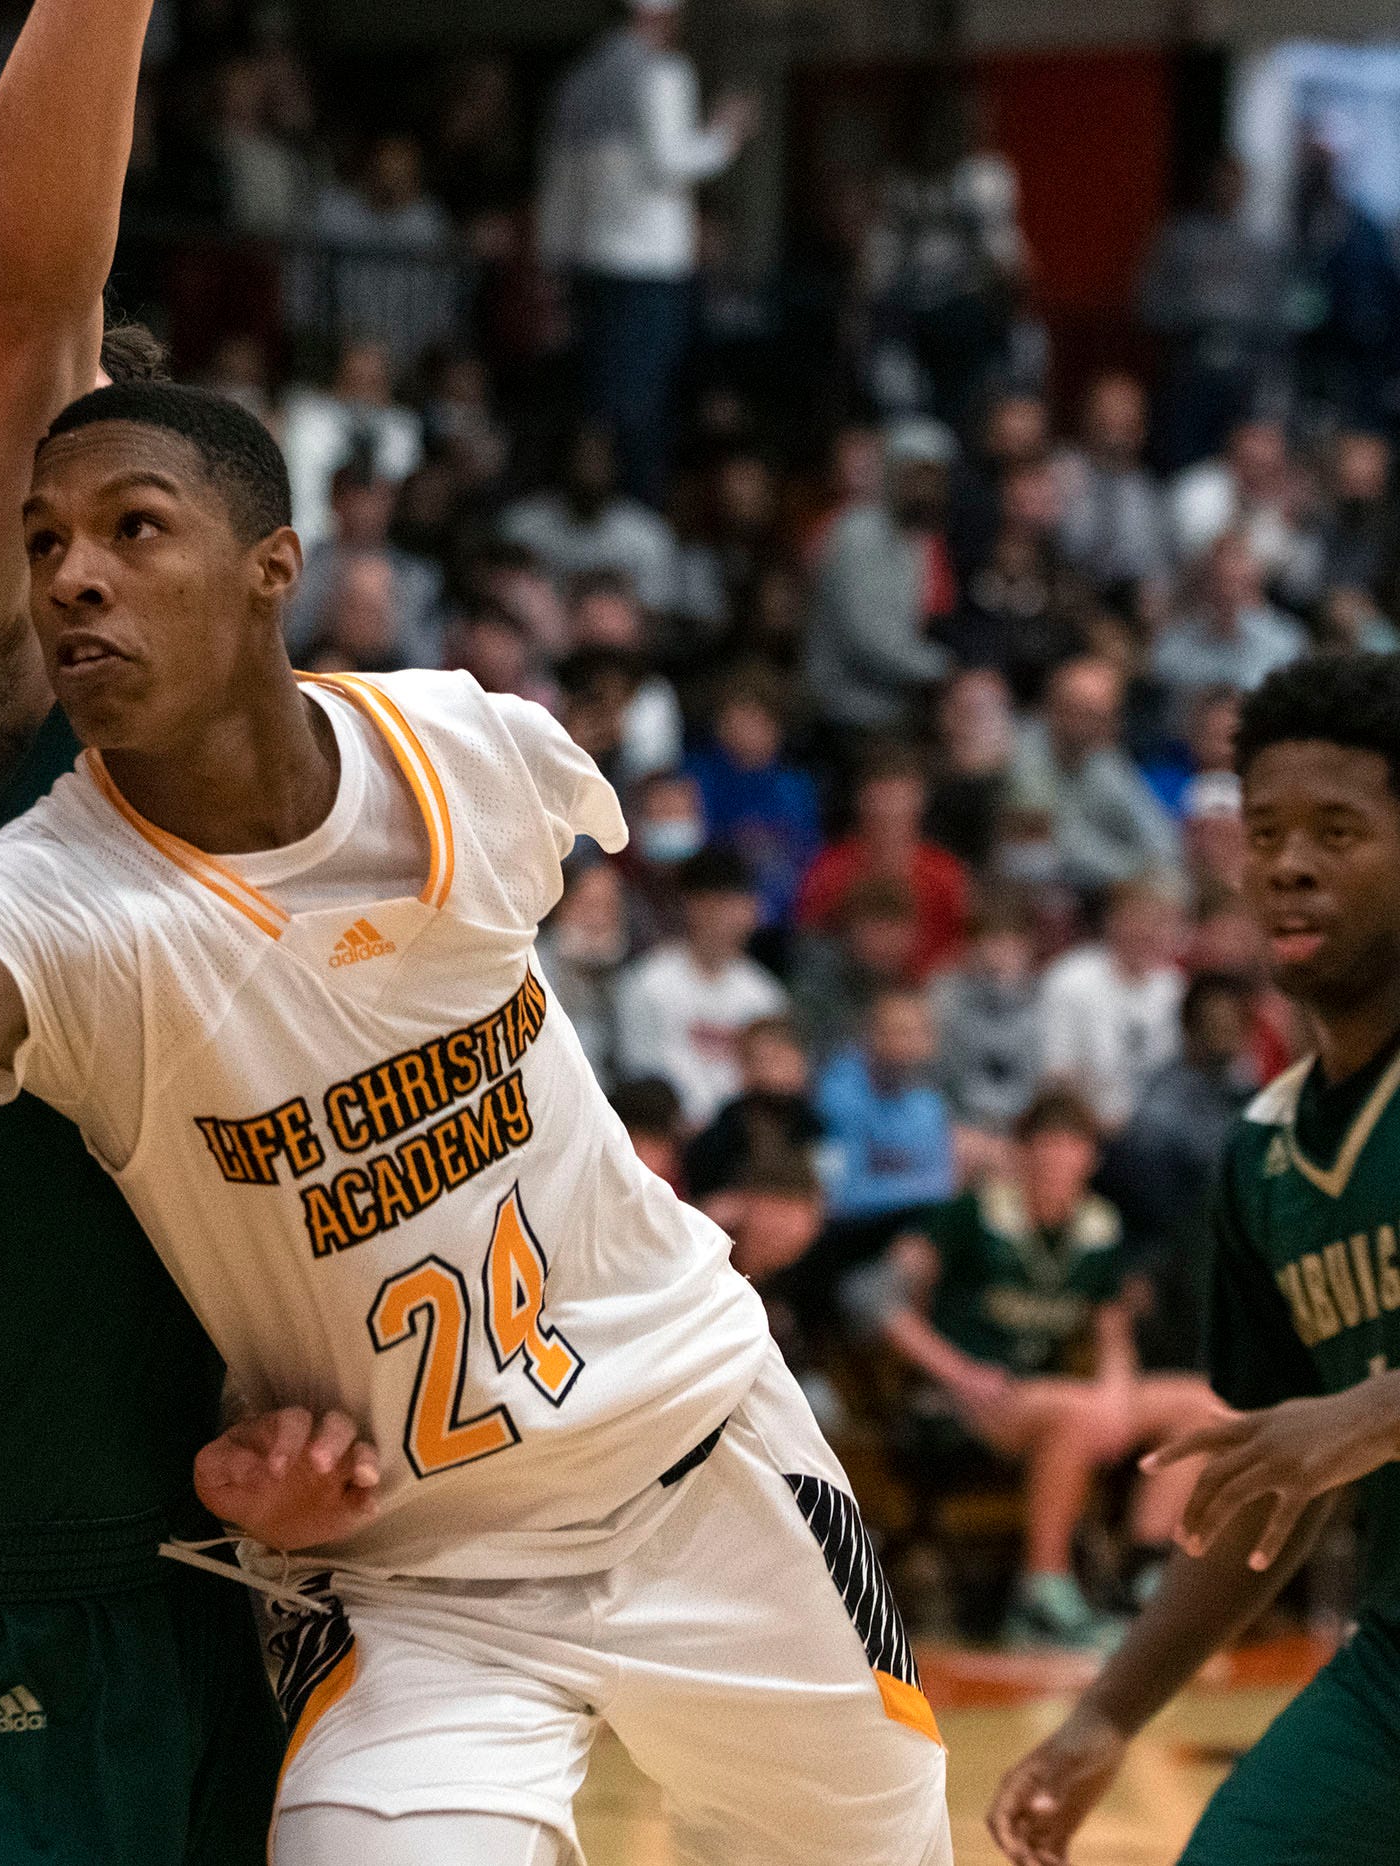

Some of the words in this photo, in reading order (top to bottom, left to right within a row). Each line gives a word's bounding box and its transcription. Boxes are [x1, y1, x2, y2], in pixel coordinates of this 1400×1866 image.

[328, 940, 397, 969] adidas
[194, 1097, 325, 1185] LIFE
[324, 955, 546, 1154] CHRISTIAN
[298, 1068, 534, 1258] ACADEMY
[366, 1178, 586, 1480] 24
